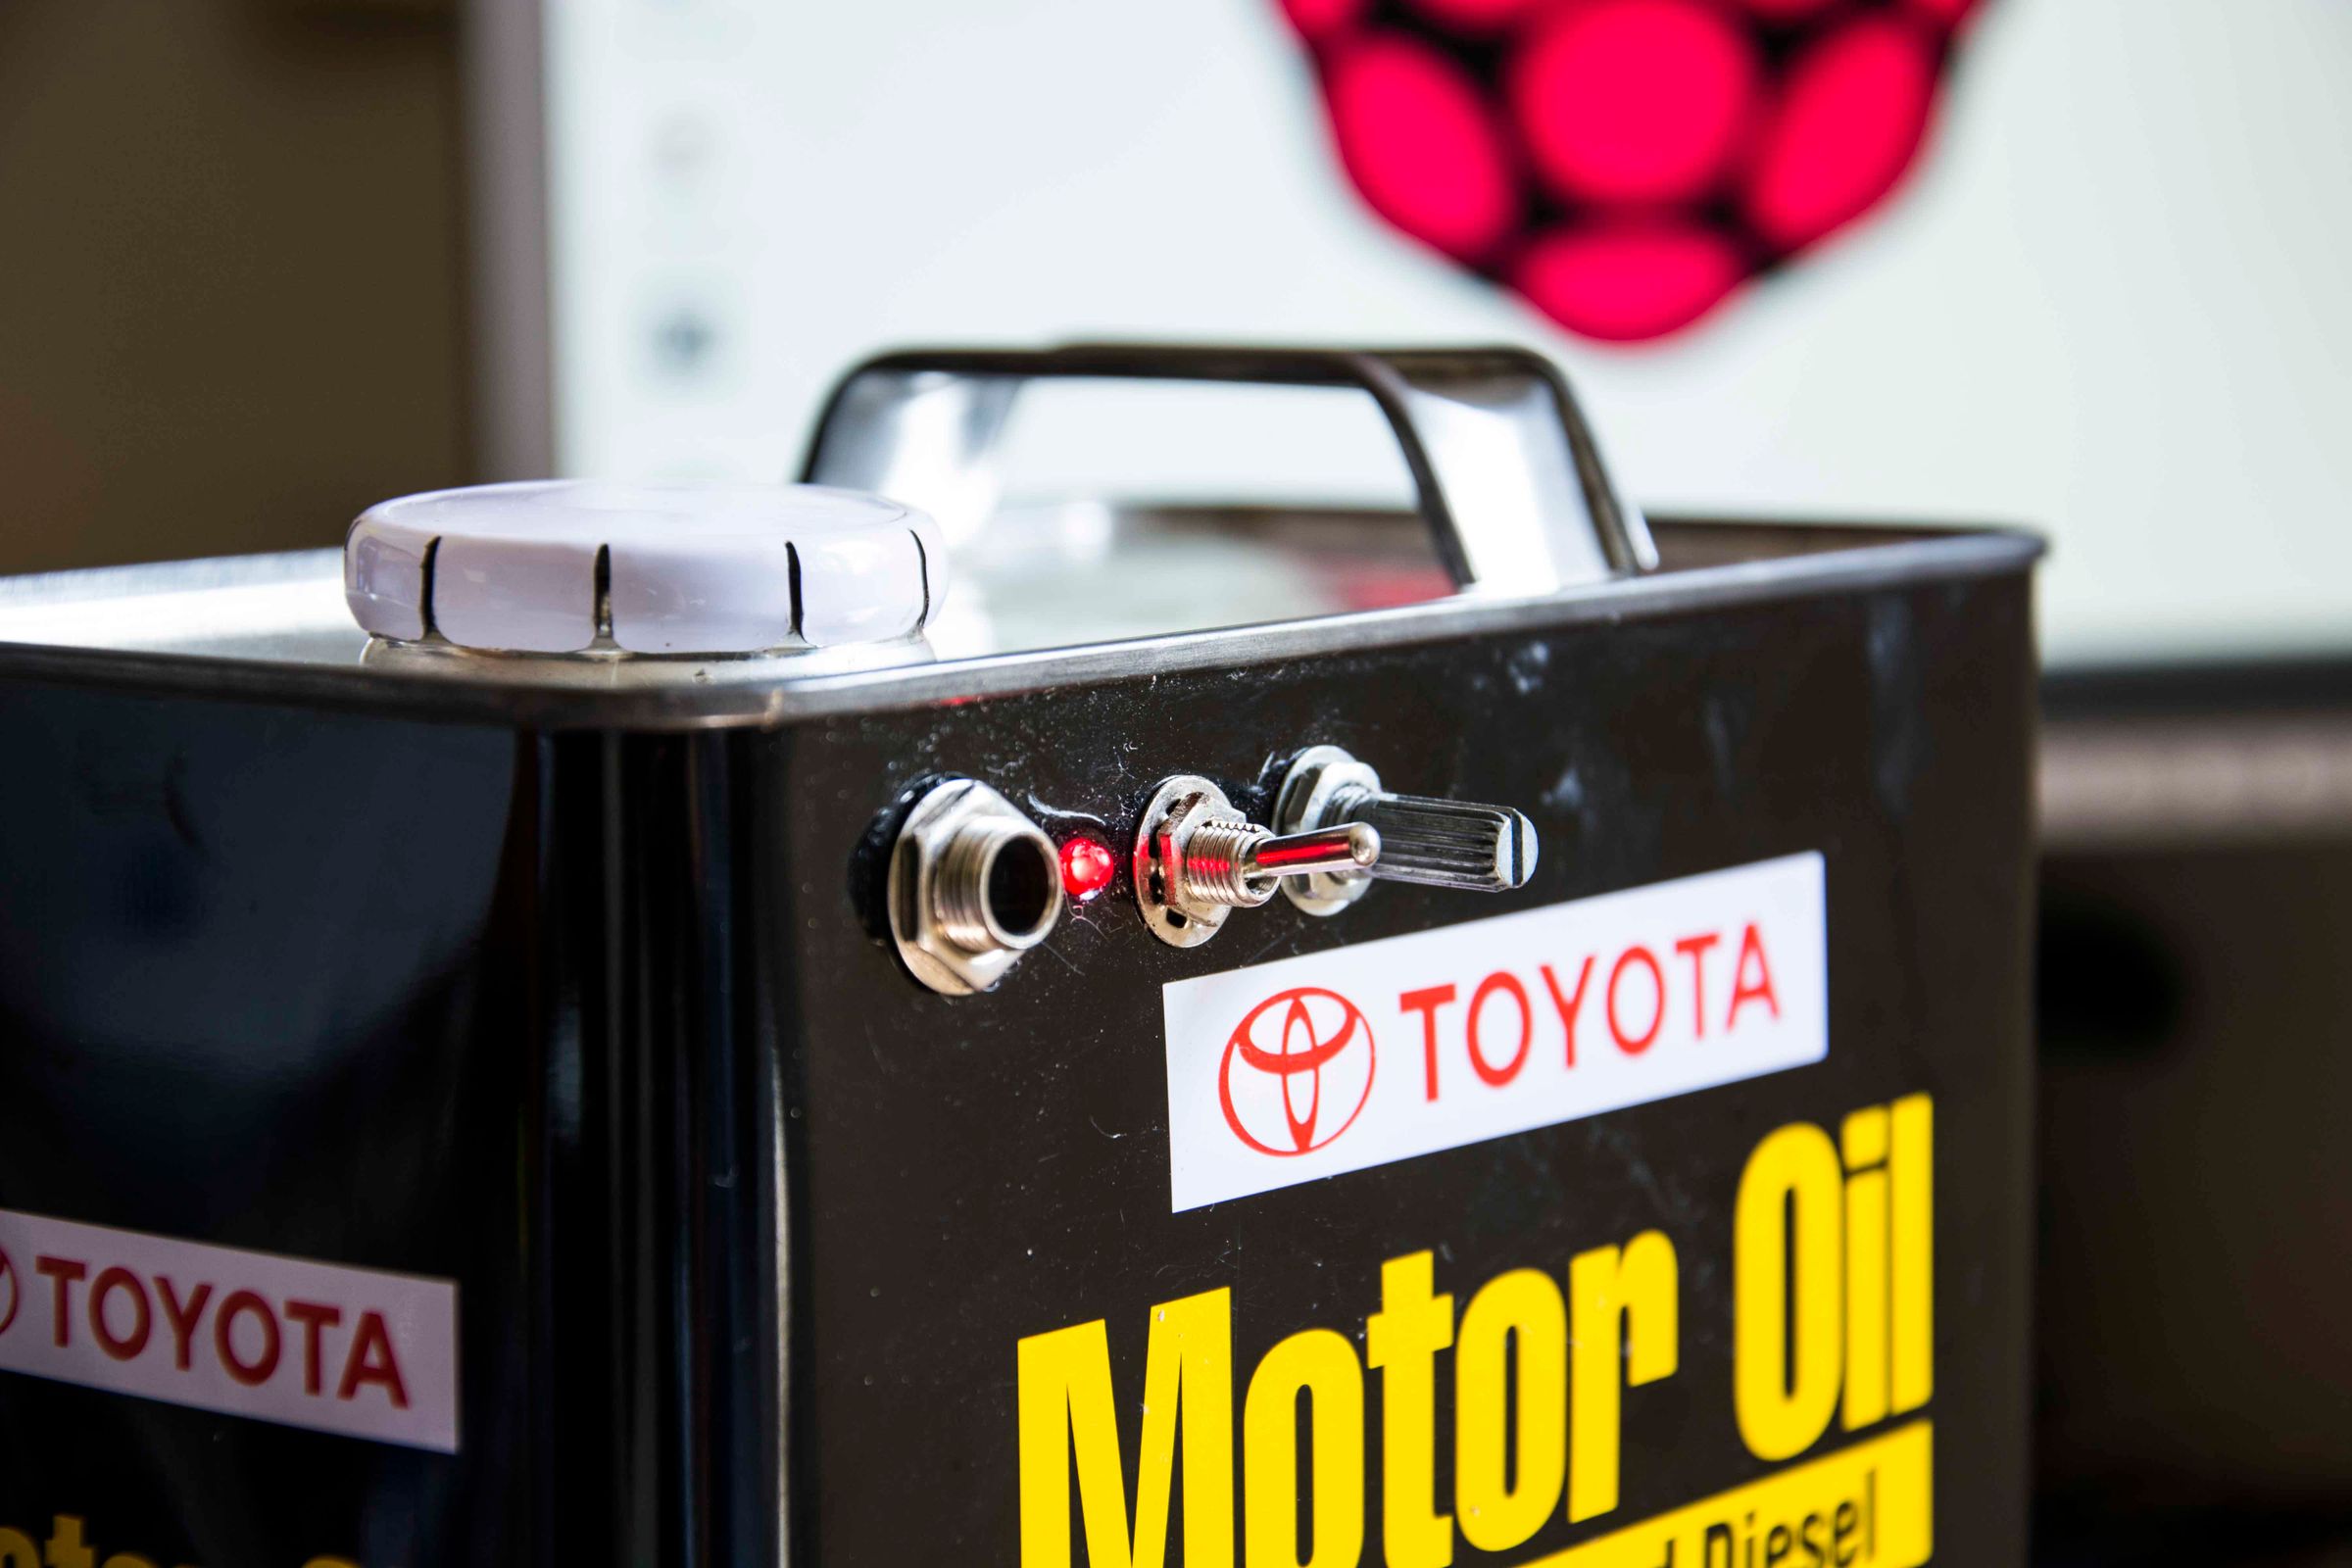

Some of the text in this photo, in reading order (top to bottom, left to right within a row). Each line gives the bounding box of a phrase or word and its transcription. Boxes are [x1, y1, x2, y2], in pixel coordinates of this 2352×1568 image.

[1400, 923, 1781, 1102] TOYOTA
[35, 1255, 410, 1409] TOYOTA
[1017, 1092, 1934, 1568] Motor Oil
